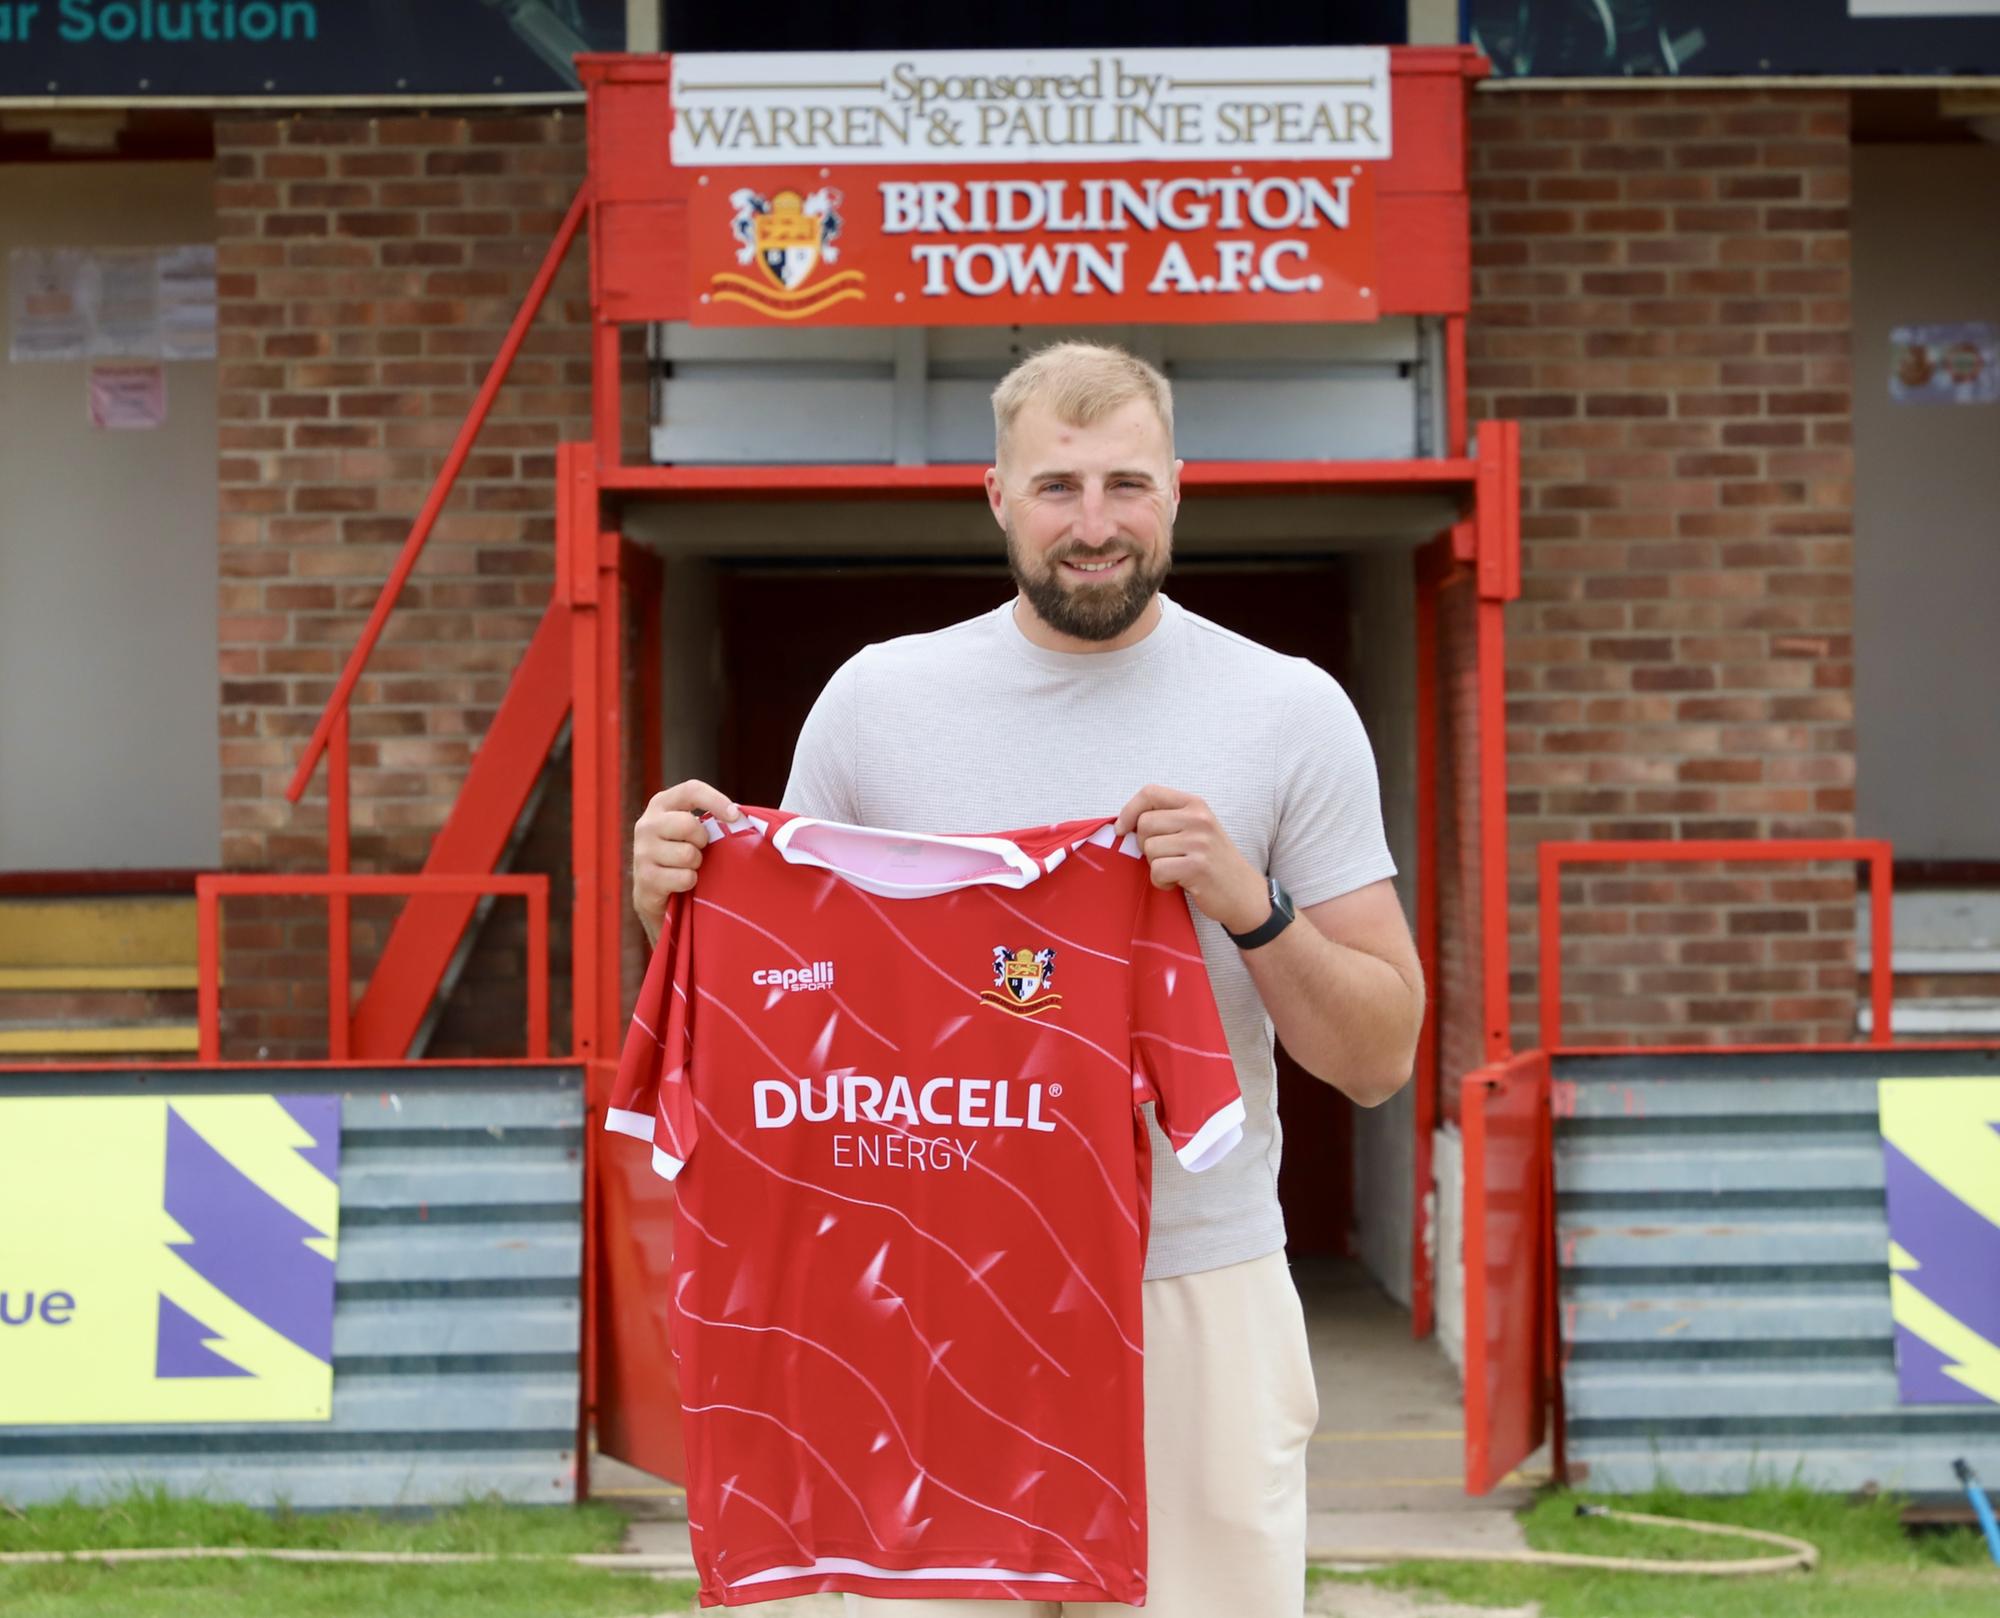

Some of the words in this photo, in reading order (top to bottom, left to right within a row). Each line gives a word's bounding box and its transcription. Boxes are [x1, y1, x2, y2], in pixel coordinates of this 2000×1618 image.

[58, 0, 318, 41] Solution
[892, 58, 1103, 117] Sponsored
[1112, 57, 1162, 112] by
[678, 105, 910, 148] WARREN
[925, 107, 964, 147] &
[977, 101, 1202, 146] PAULINE
[1215, 100, 1381, 144] SPEAR
[879, 177, 1355, 235] BRIDLINGTON
[911, 242, 1128, 296] TOWN
[1147, 239, 1324, 294] A.F.C.
[752, 961, 834, 990] capelli
[790, 981, 834, 992] SPORT
[832, 1134, 978, 1172] ENERGY
